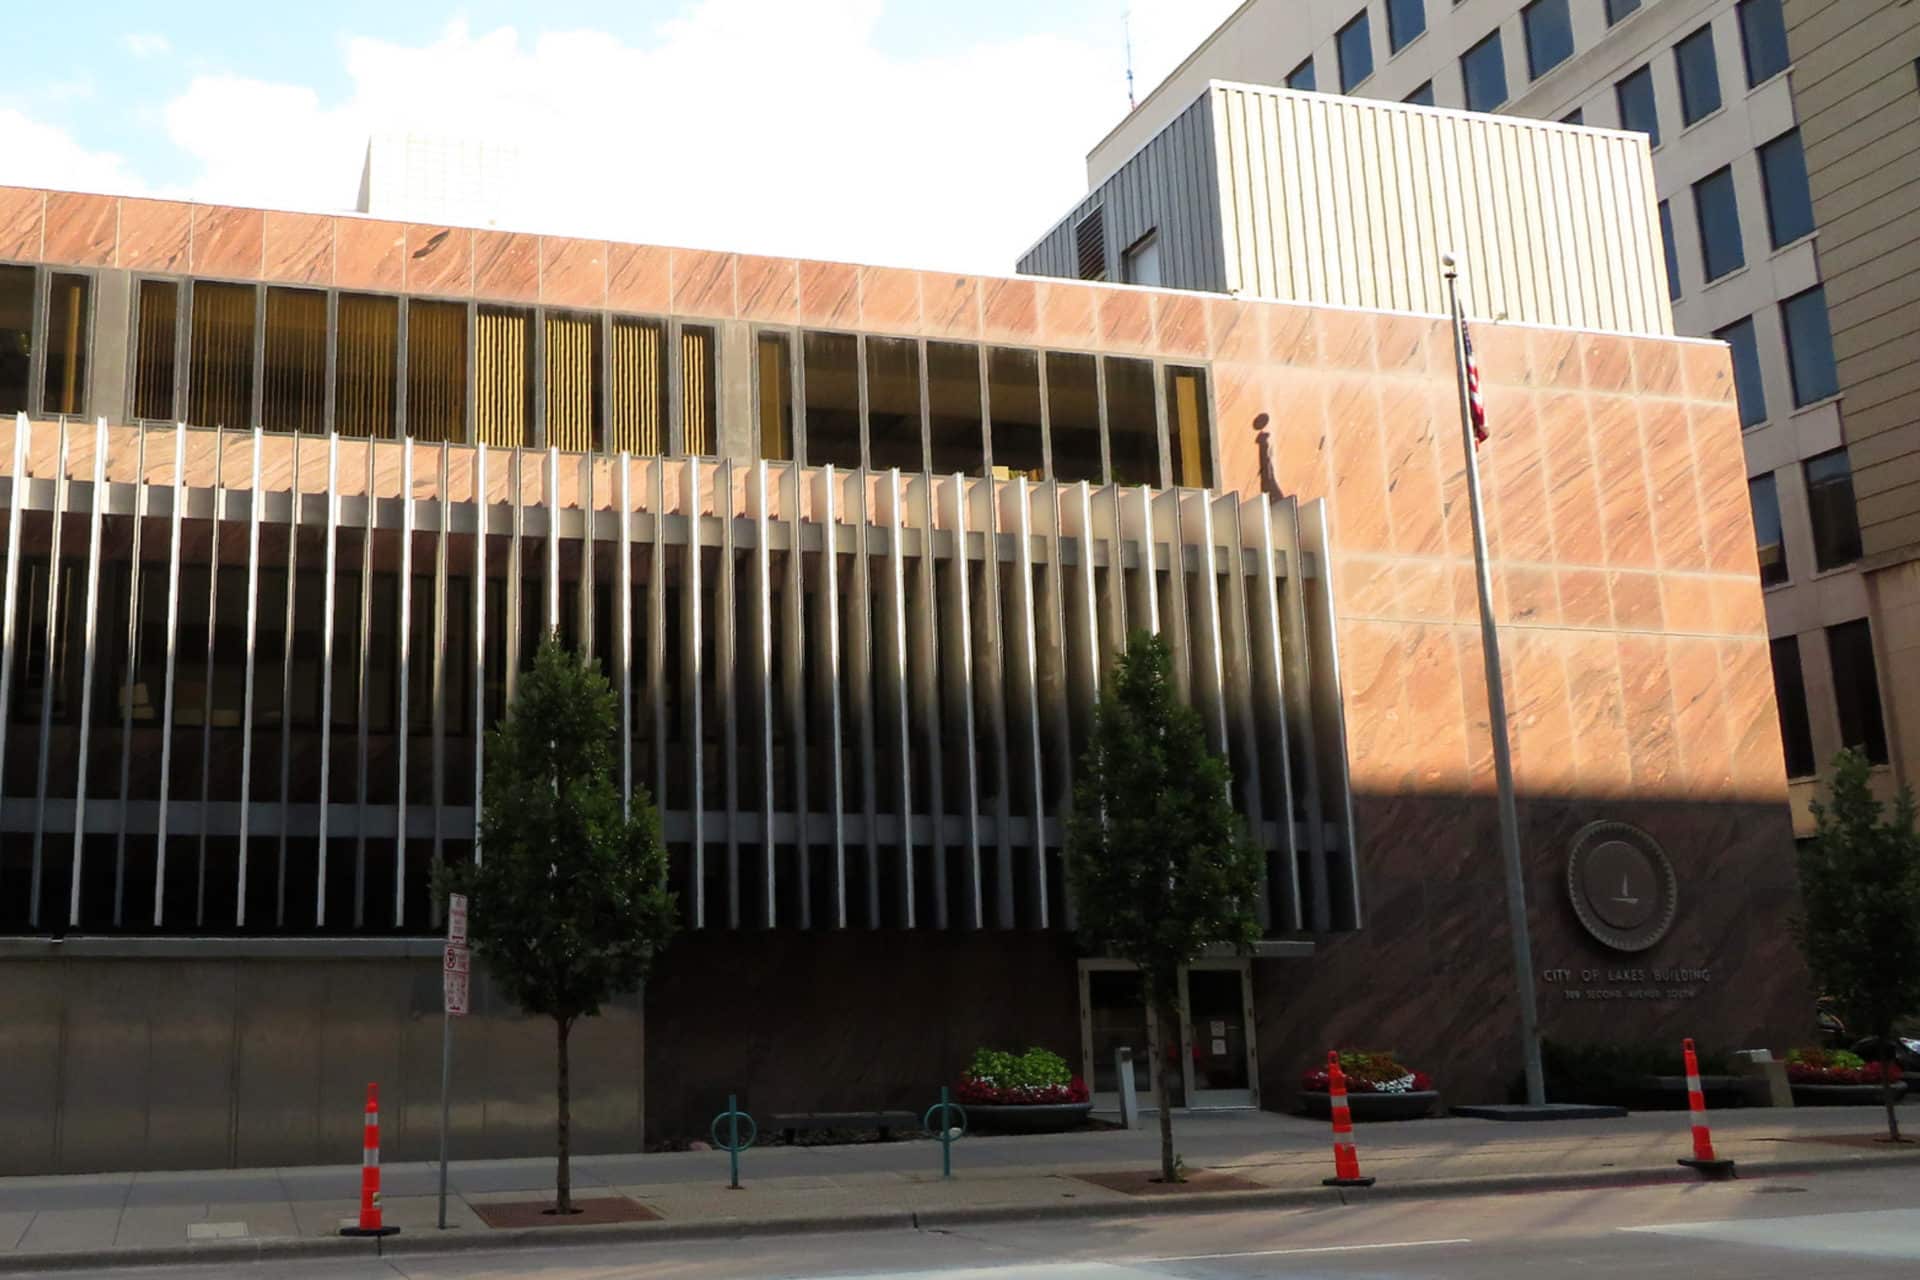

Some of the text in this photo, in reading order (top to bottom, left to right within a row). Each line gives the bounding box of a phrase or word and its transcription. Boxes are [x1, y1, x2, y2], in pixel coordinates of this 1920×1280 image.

[1543, 968, 1712, 982] CITY OF LAKES BUILDING
